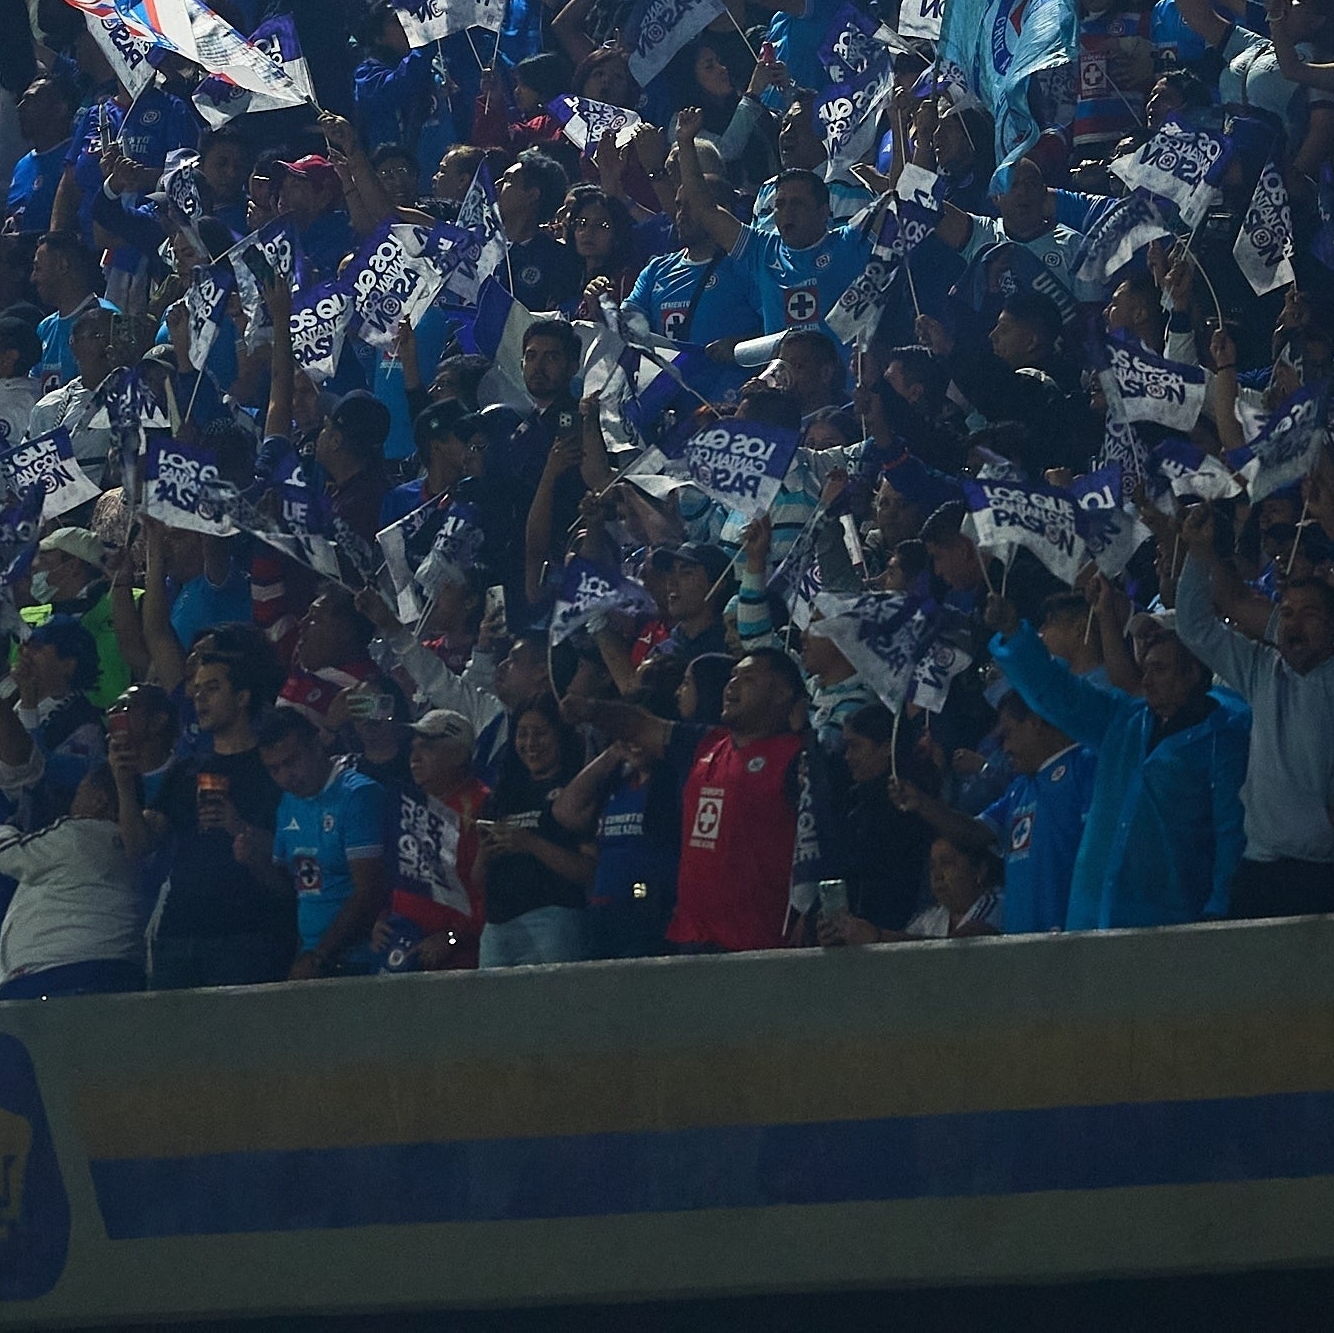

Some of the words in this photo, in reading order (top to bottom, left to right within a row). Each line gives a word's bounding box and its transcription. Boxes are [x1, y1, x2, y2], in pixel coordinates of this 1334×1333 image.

[316, 293, 347, 321] QU
[12, 439, 58, 467] QUE
[158, 449, 200, 481] LOS
[982, 485, 1027, 505] LOS
[1029, 492, 1075, 517] QUE
